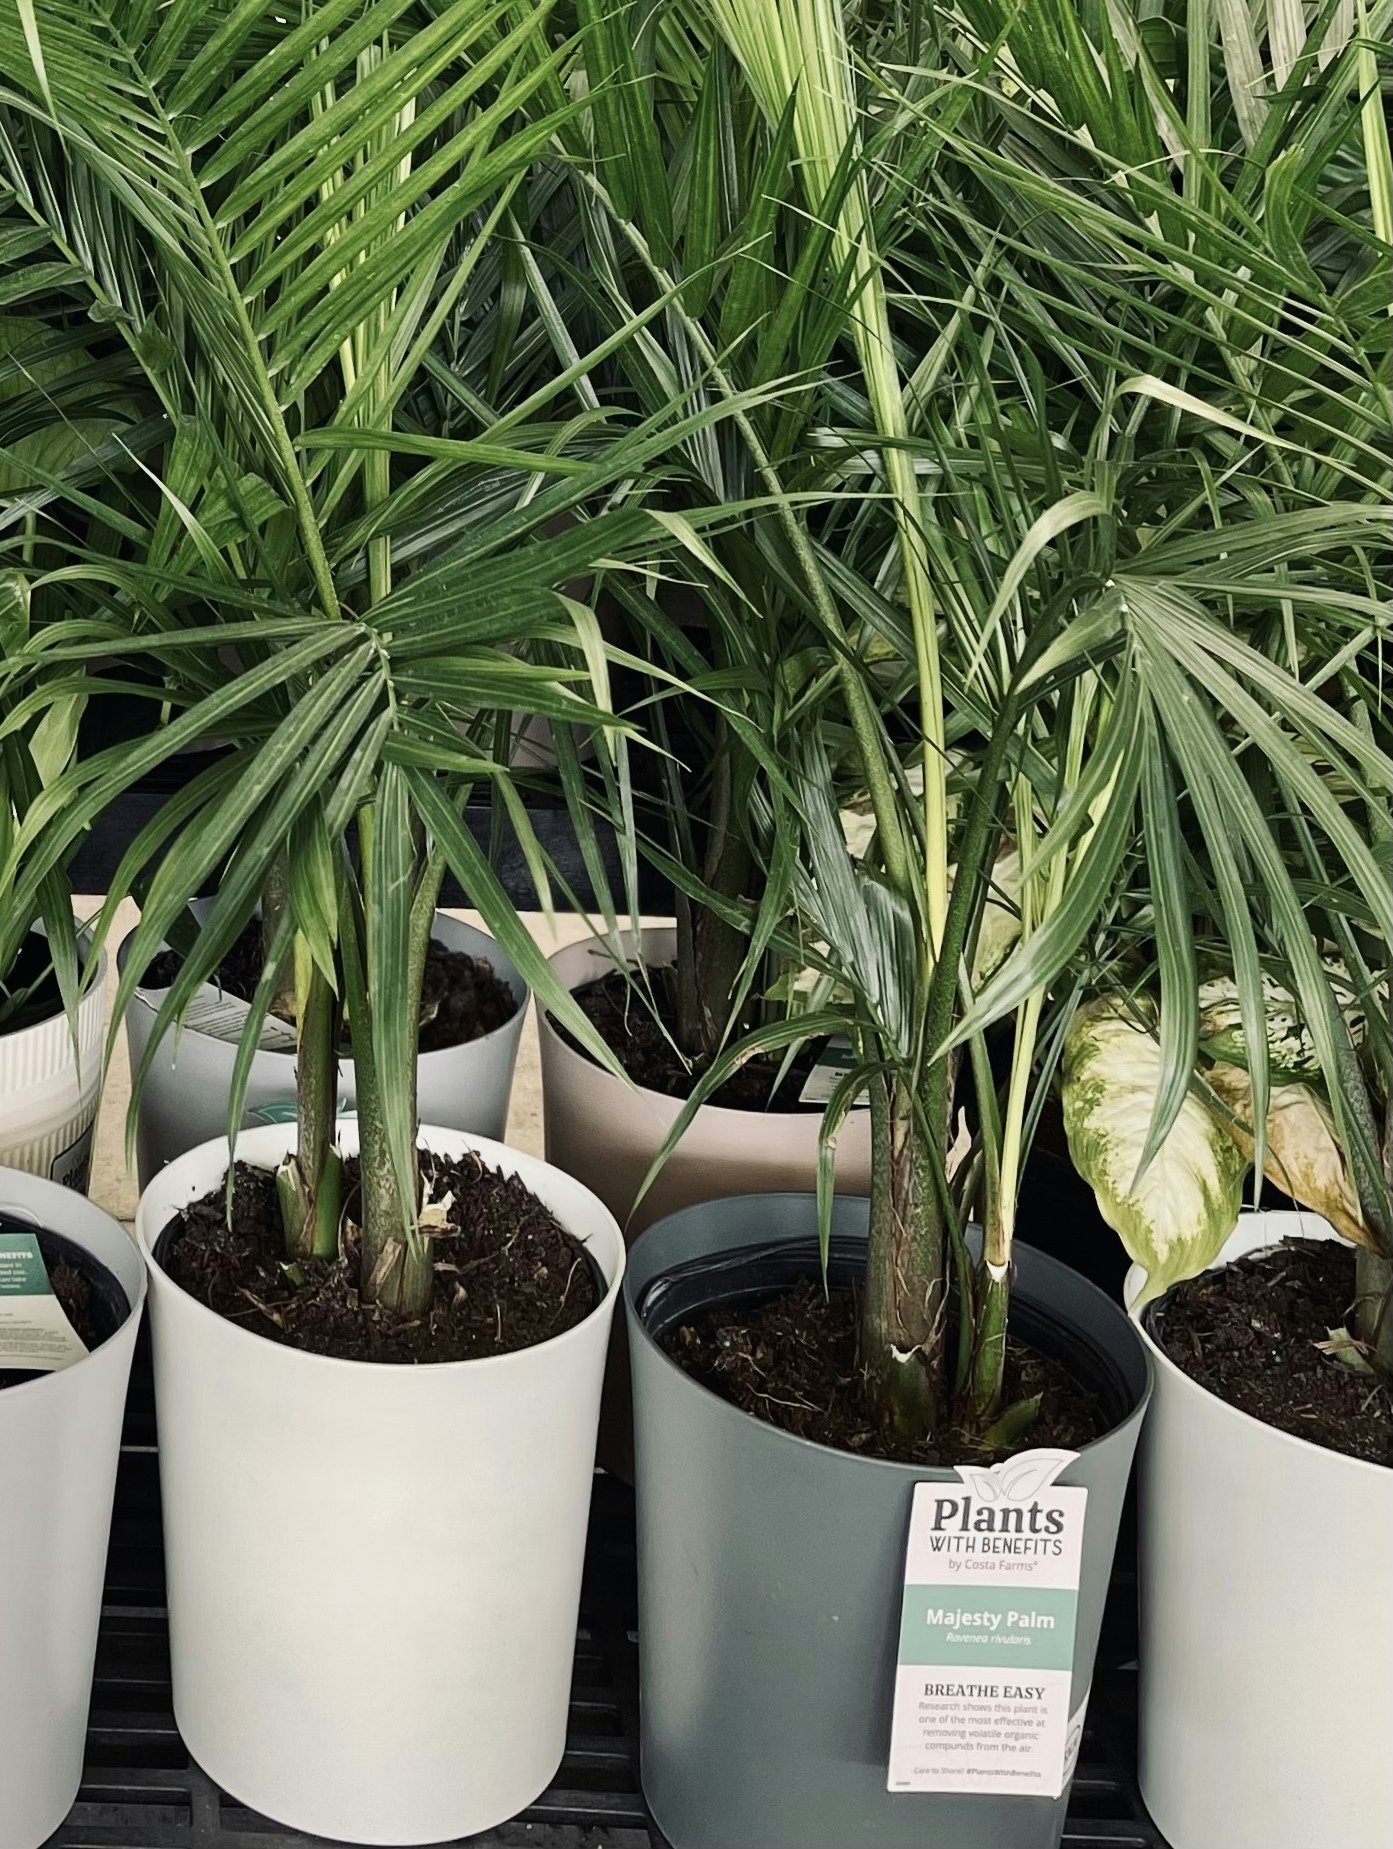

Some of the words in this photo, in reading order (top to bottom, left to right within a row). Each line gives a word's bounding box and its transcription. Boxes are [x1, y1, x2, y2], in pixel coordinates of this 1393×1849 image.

[931, 1496, 1065, 1535] Plants
[930, 1535, 976, 1553] WITH
[981, 1537, 1063, 1556] BENEFITS
[948, 1558, 962, 1572] by
[965, 1559, 996, 1570] Costa
[926, 1608, 1002, 1631] Majesty
[1007, 1611, 1055, 1629] Palm
[946, 1632, 988, 1643] Ravenea
[990, 1633, 1032, 1646] rivularis
[924, 1683, 1000, 1698] BREATHE
[1003, 1686, 1046, 1700] EASY
[918, 1702, 960, 1711] Research
[963, 1703, 992, 1712] shows
[994, 1703, 1011, 1713] this
[1013, 1704, 1038, 1715] plant
[1040, 1705, 1048, 1714] is
[918, 1716, 937, 1724] one
[939, 1714, 949, 1724] of
[951, 1715, 966, 1725] the
[968, 1716, 992, 1725] most
[994, 1716, 1034, 1727] effective
[1036, 1718, 1045, 1728] at
[923, 1729, 967, 1740] removing
[968, 1728, 1002, 1738] volatile
[1004, 1730, 1039, 1741] organic
[976, 1742, 999, 1752] from
[1001, 1742, 1017, 1752] the
